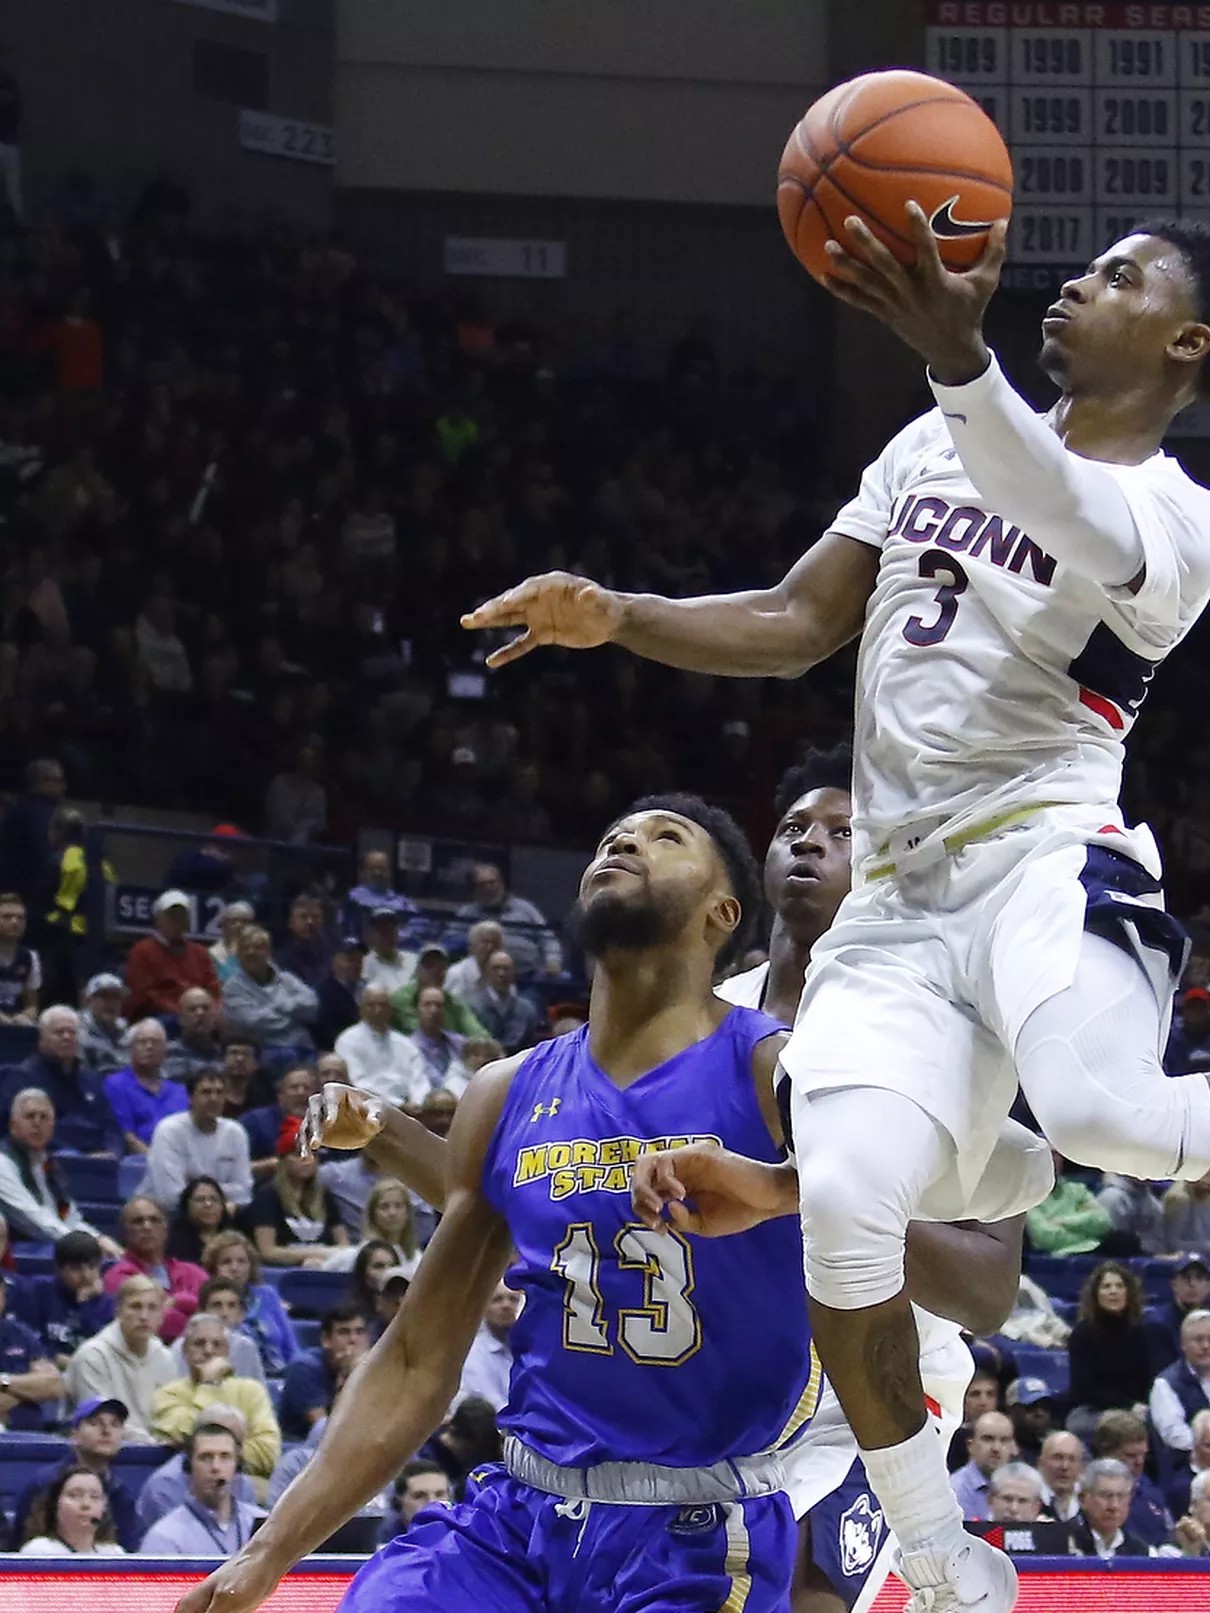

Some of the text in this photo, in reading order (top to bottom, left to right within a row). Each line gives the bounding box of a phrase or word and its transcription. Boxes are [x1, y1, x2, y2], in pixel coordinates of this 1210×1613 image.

[939, 4, 1104, 25] REGULAR
[938, 37, 996, 73] 1989
[1022, 38, 1081, 74] 1990
[1110, 40, 1163, 75] 1991
[1023, 97, 1081, 133] 1999
[1105, 99, 1167, 135] 2000
[1106, 158, 1168, 194] 2009
[1022, 216, 1080, 252] 2017
[521, 245, 548, 272] 11
[902, 549, 969, 647] 3
[119, 895, 153, 918] SE
[549, 1165, 636, 1202] STA
[550, 1222, 702, 1367] 13
